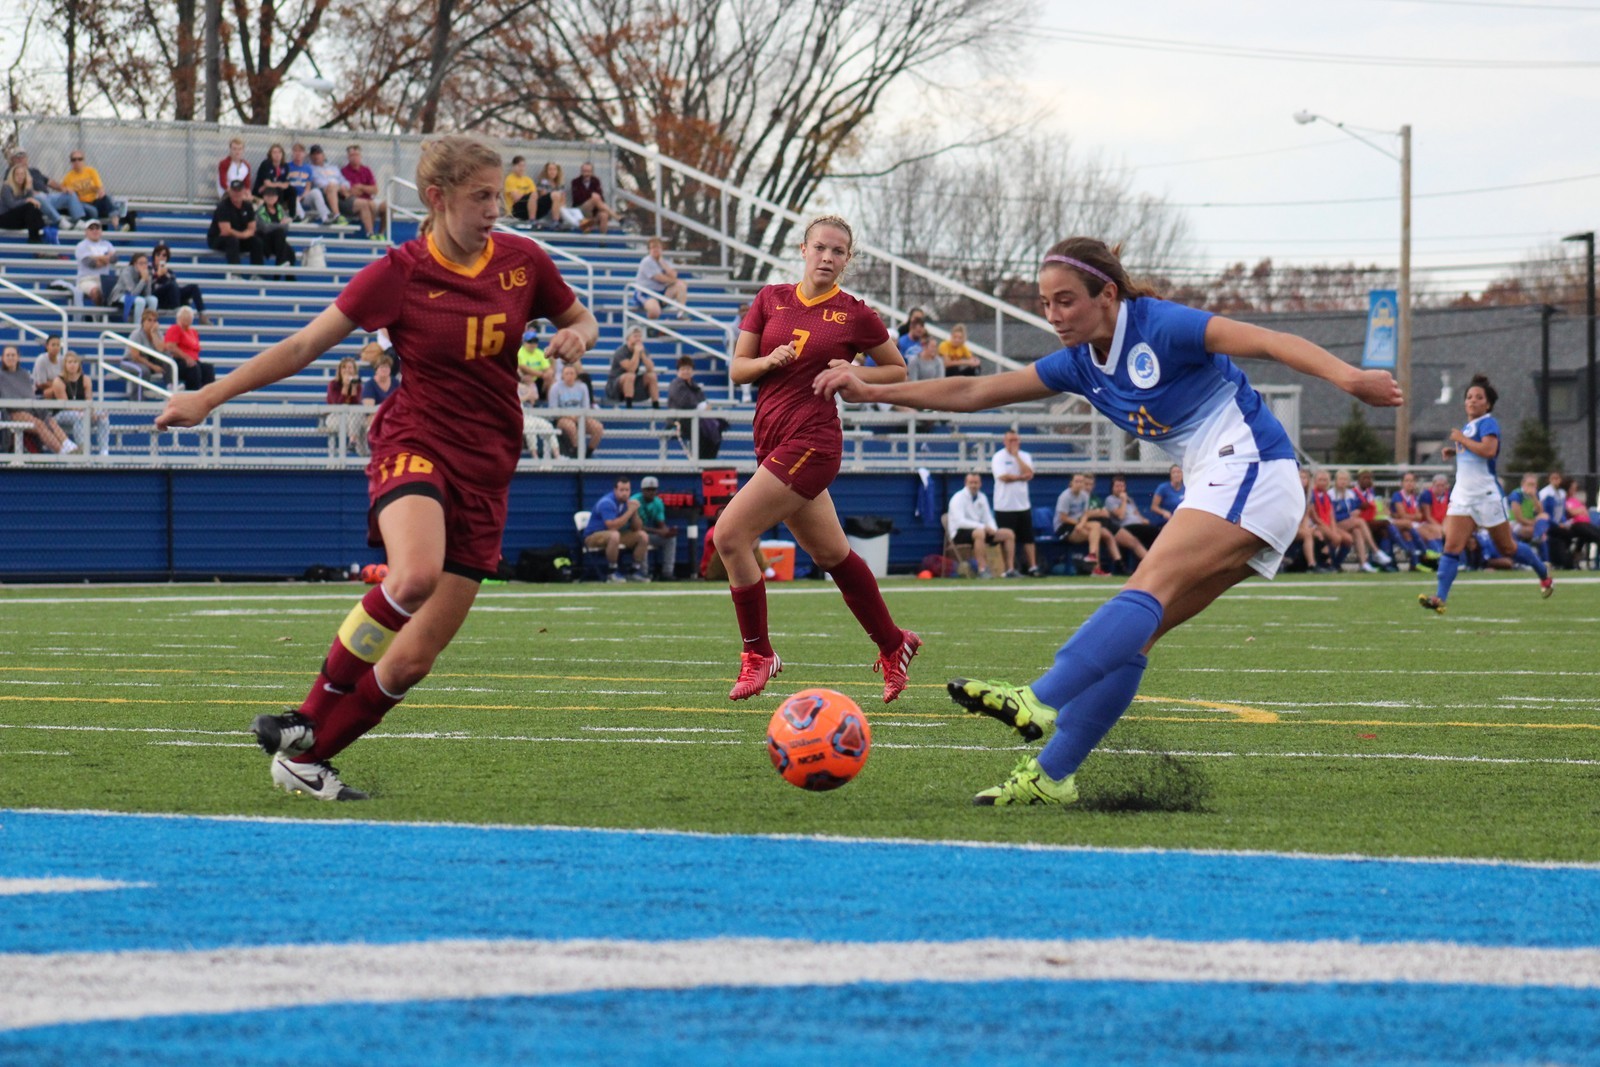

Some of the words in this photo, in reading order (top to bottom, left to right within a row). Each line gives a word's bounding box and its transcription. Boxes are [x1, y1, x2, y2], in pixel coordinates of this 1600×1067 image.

[499, 267, 527, 290] UC
[822, 309, 847, 325] UC
[465, 313, 506, 360] 16
[792, 328, 810, 360] 7
[350, 622, 384, 656] C
